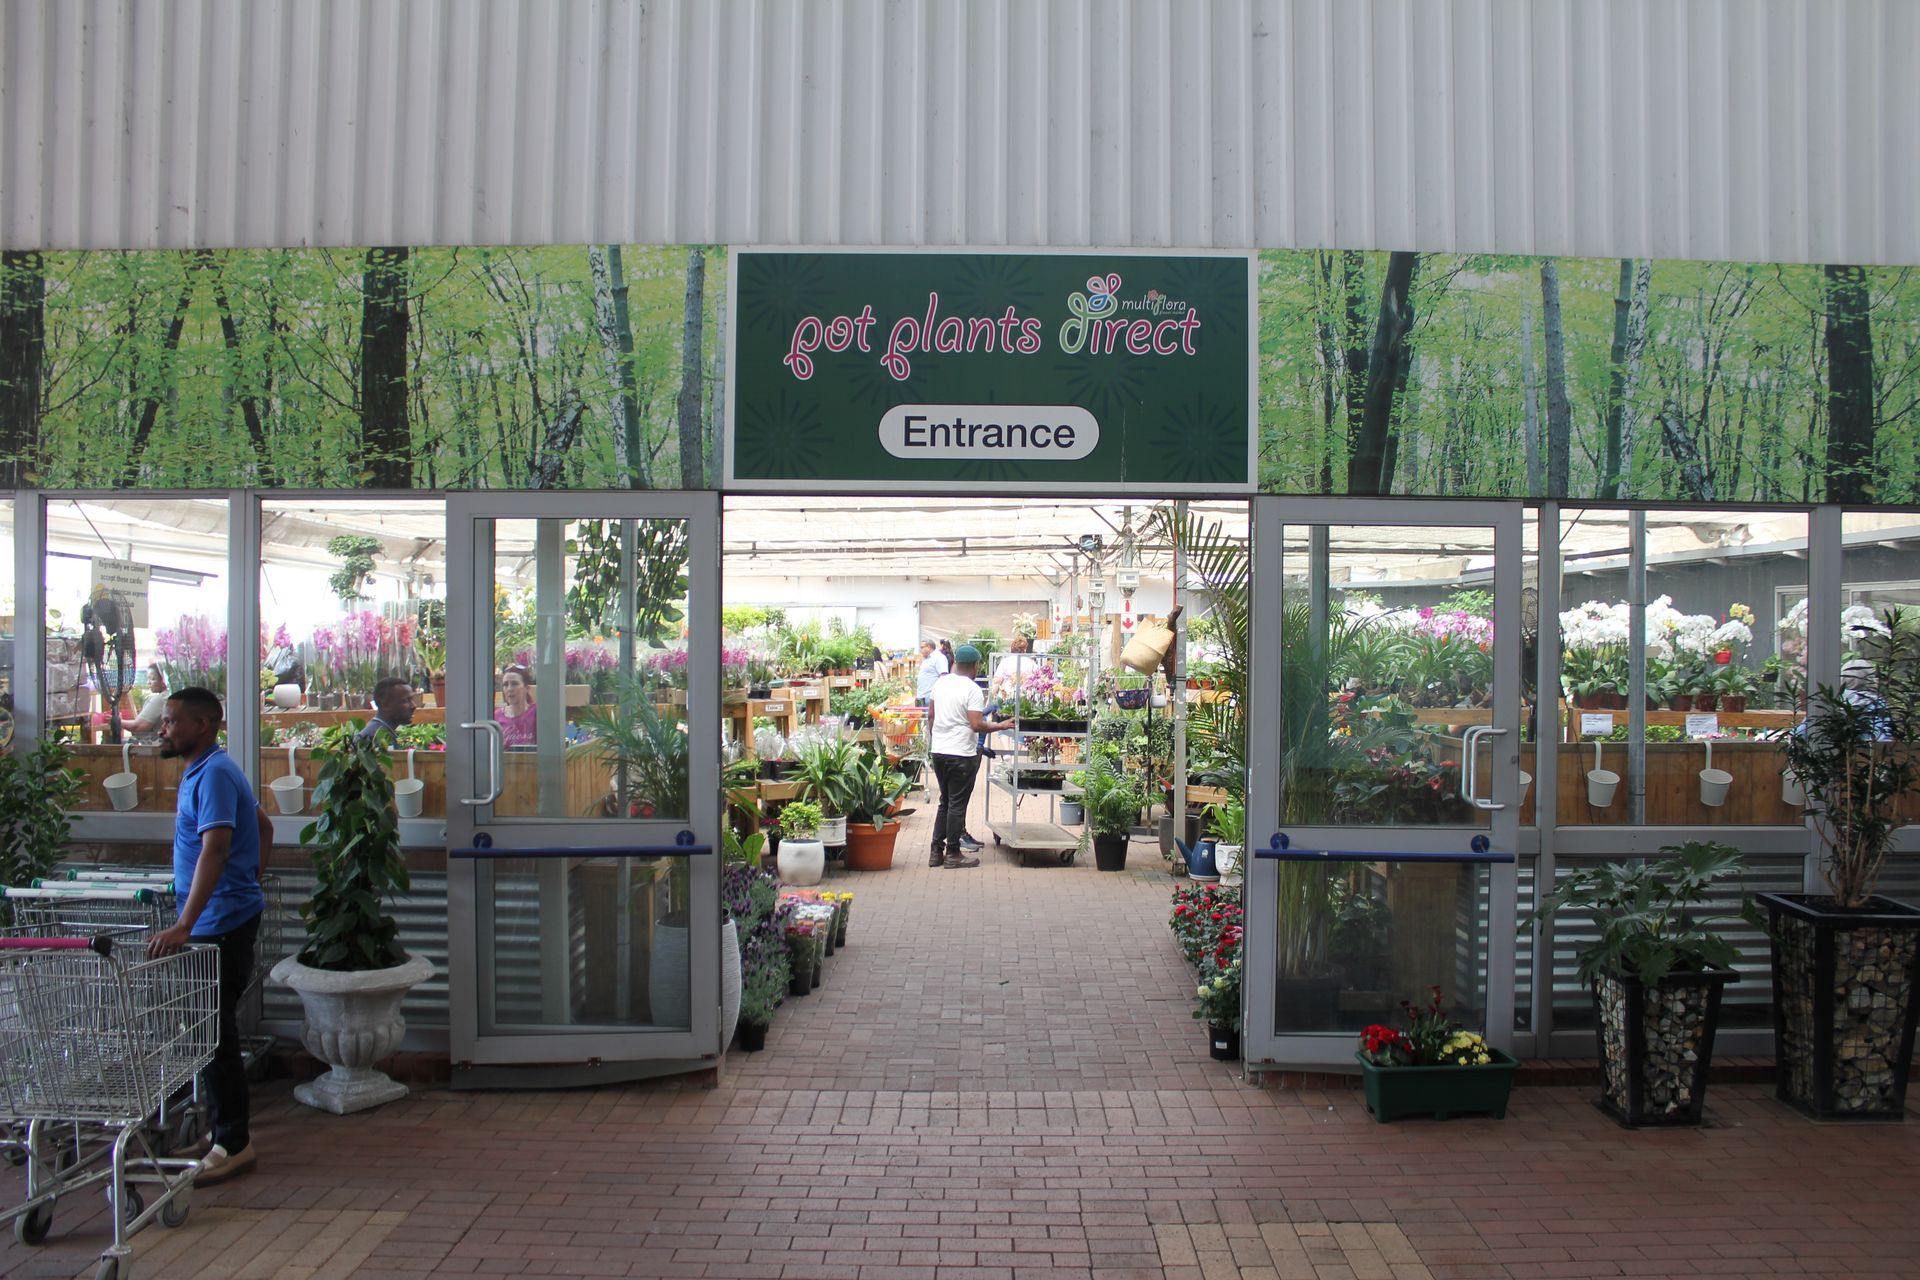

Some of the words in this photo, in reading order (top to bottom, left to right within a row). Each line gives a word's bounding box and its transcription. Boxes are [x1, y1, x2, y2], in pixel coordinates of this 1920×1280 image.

[1121, 294, 1186, 316] multiflora
[783, 304, 877, 381] pot
[880, 291, 1042, 381] plants
[1058, 273, 1201, 356] direct
[903, 414, 1076, 450] Entrance
